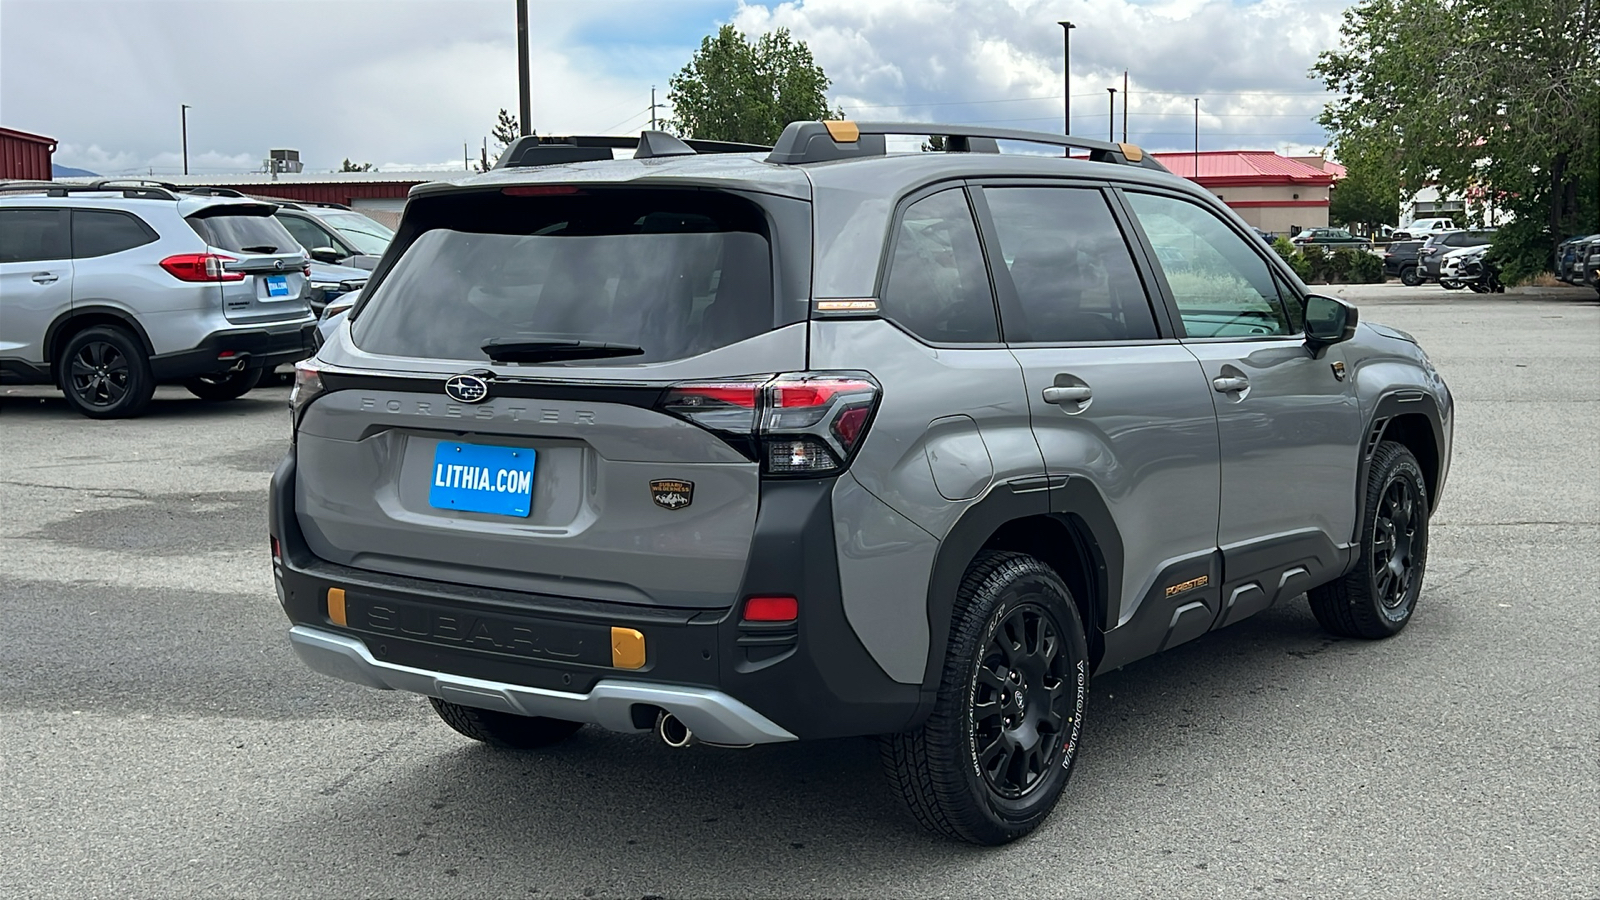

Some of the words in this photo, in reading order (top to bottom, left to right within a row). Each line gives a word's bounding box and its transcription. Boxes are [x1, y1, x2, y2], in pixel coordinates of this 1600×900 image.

[360, 397, 597, 426] FORESTER
[434, 462, 531, 495] LITHIA.COM
[1165, 575, 1209, 598] FORESTER
[367, 605, 584, 658] SUBARU
[1061, 659, 1085, 770] YOKOHAMA
